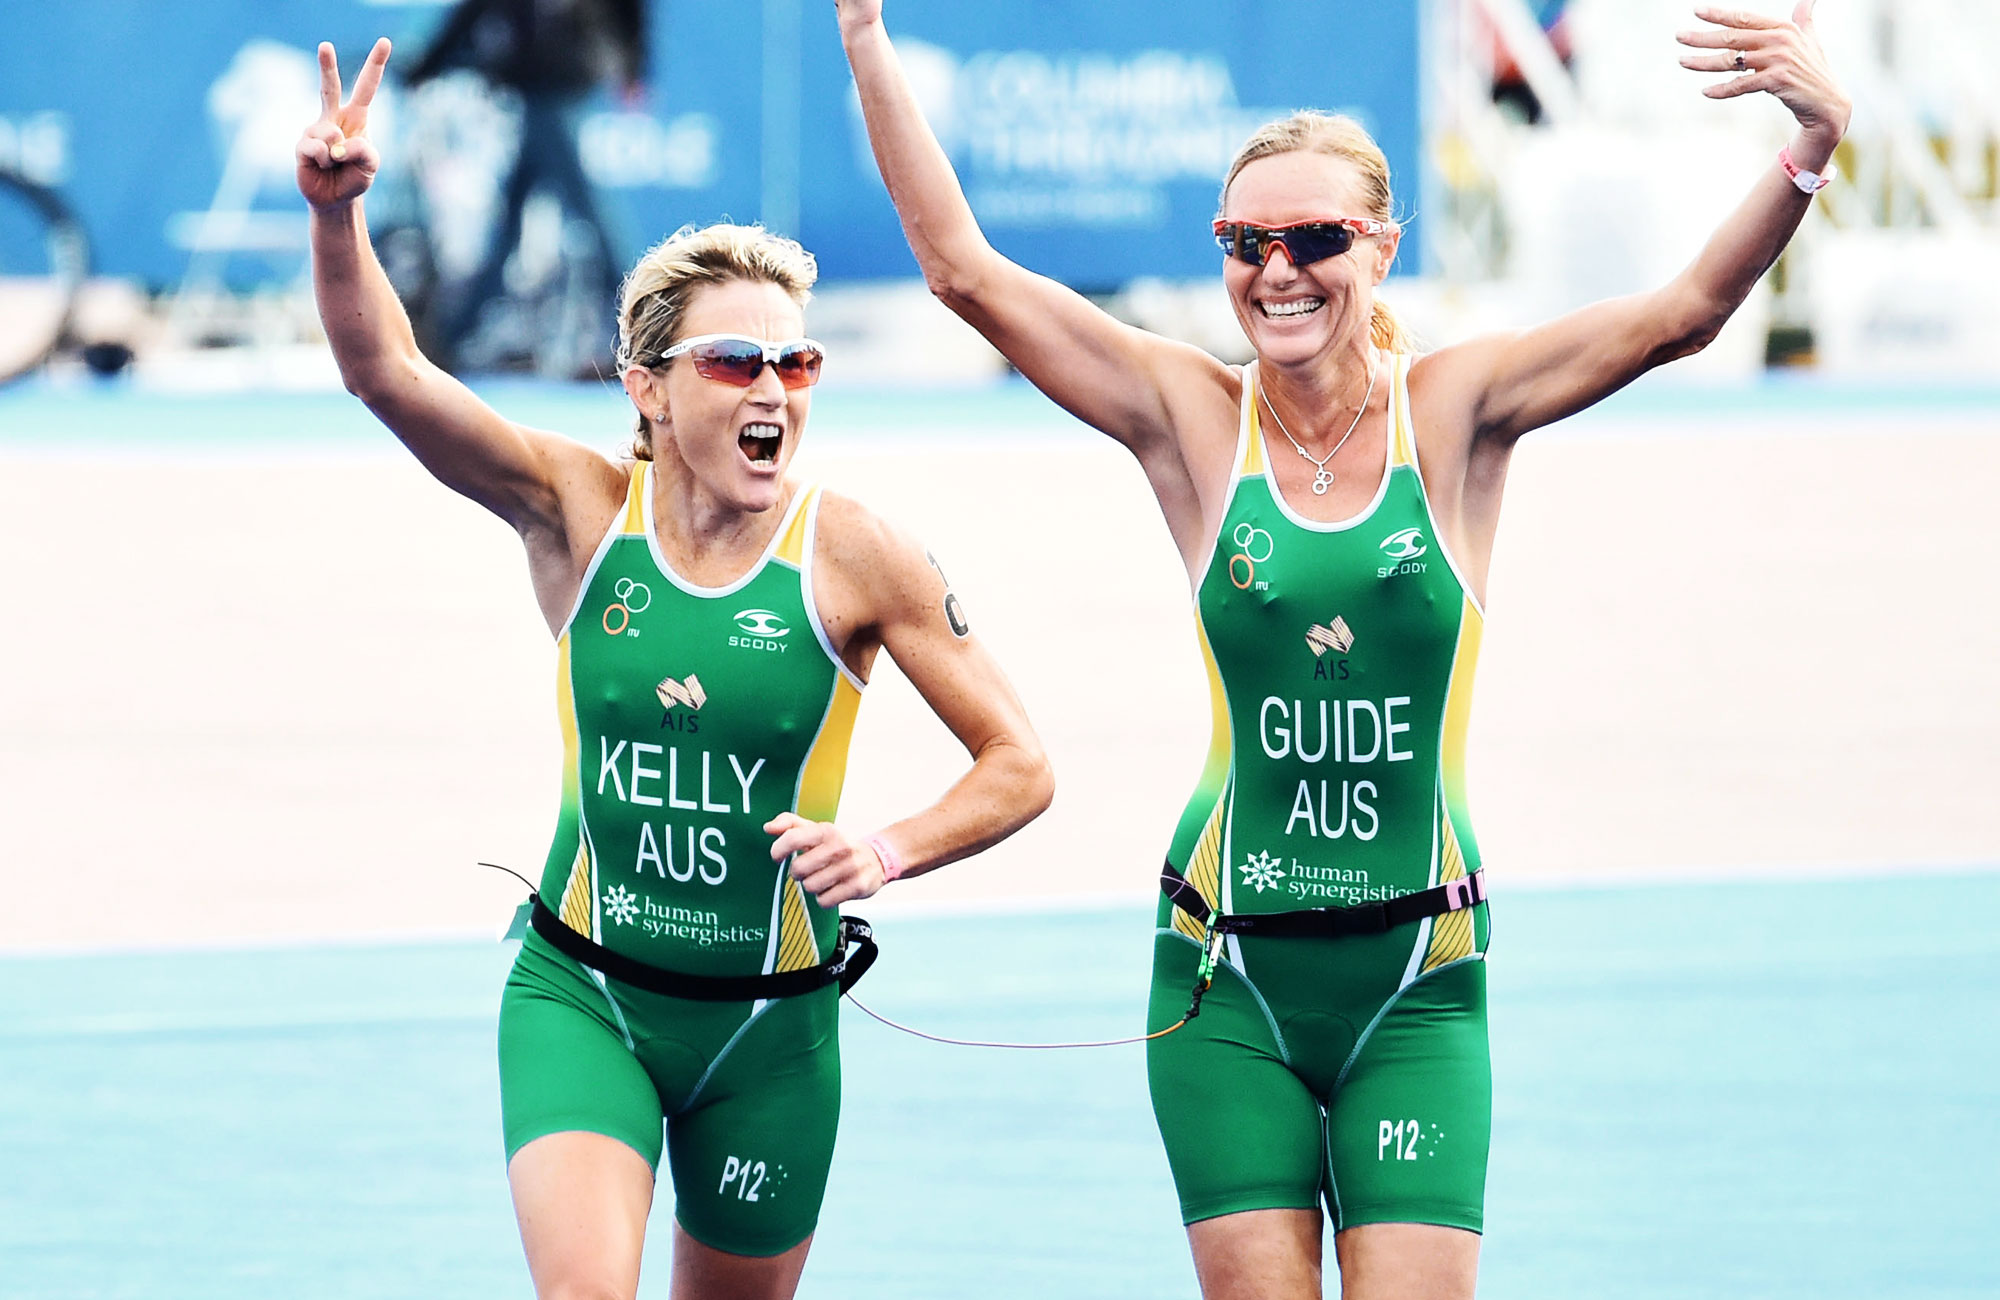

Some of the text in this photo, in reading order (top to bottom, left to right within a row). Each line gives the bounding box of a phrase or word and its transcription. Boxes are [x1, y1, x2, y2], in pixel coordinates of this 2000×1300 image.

[1377, 562, 1428, 578] SCODY
[728, 636, 788, 653] SCODY
[1314, 659, 1350, 681] AIS
[660, 711, 700, 734] AIS
[1260, 696, 1414, 763] GUIDE
[597, 736, 766, 814] KELLY
[1285, 780, 1379, 841] AUS
[635, 822, 728, 885] AUS
[1291, 858, 1369, 883] human
[645, 896, 719, 925] human
[642, 915, 764, 945] synergistics
[1379, 1119, 1420, 1161] P12
[719, 1155, 766, 1202] P12
